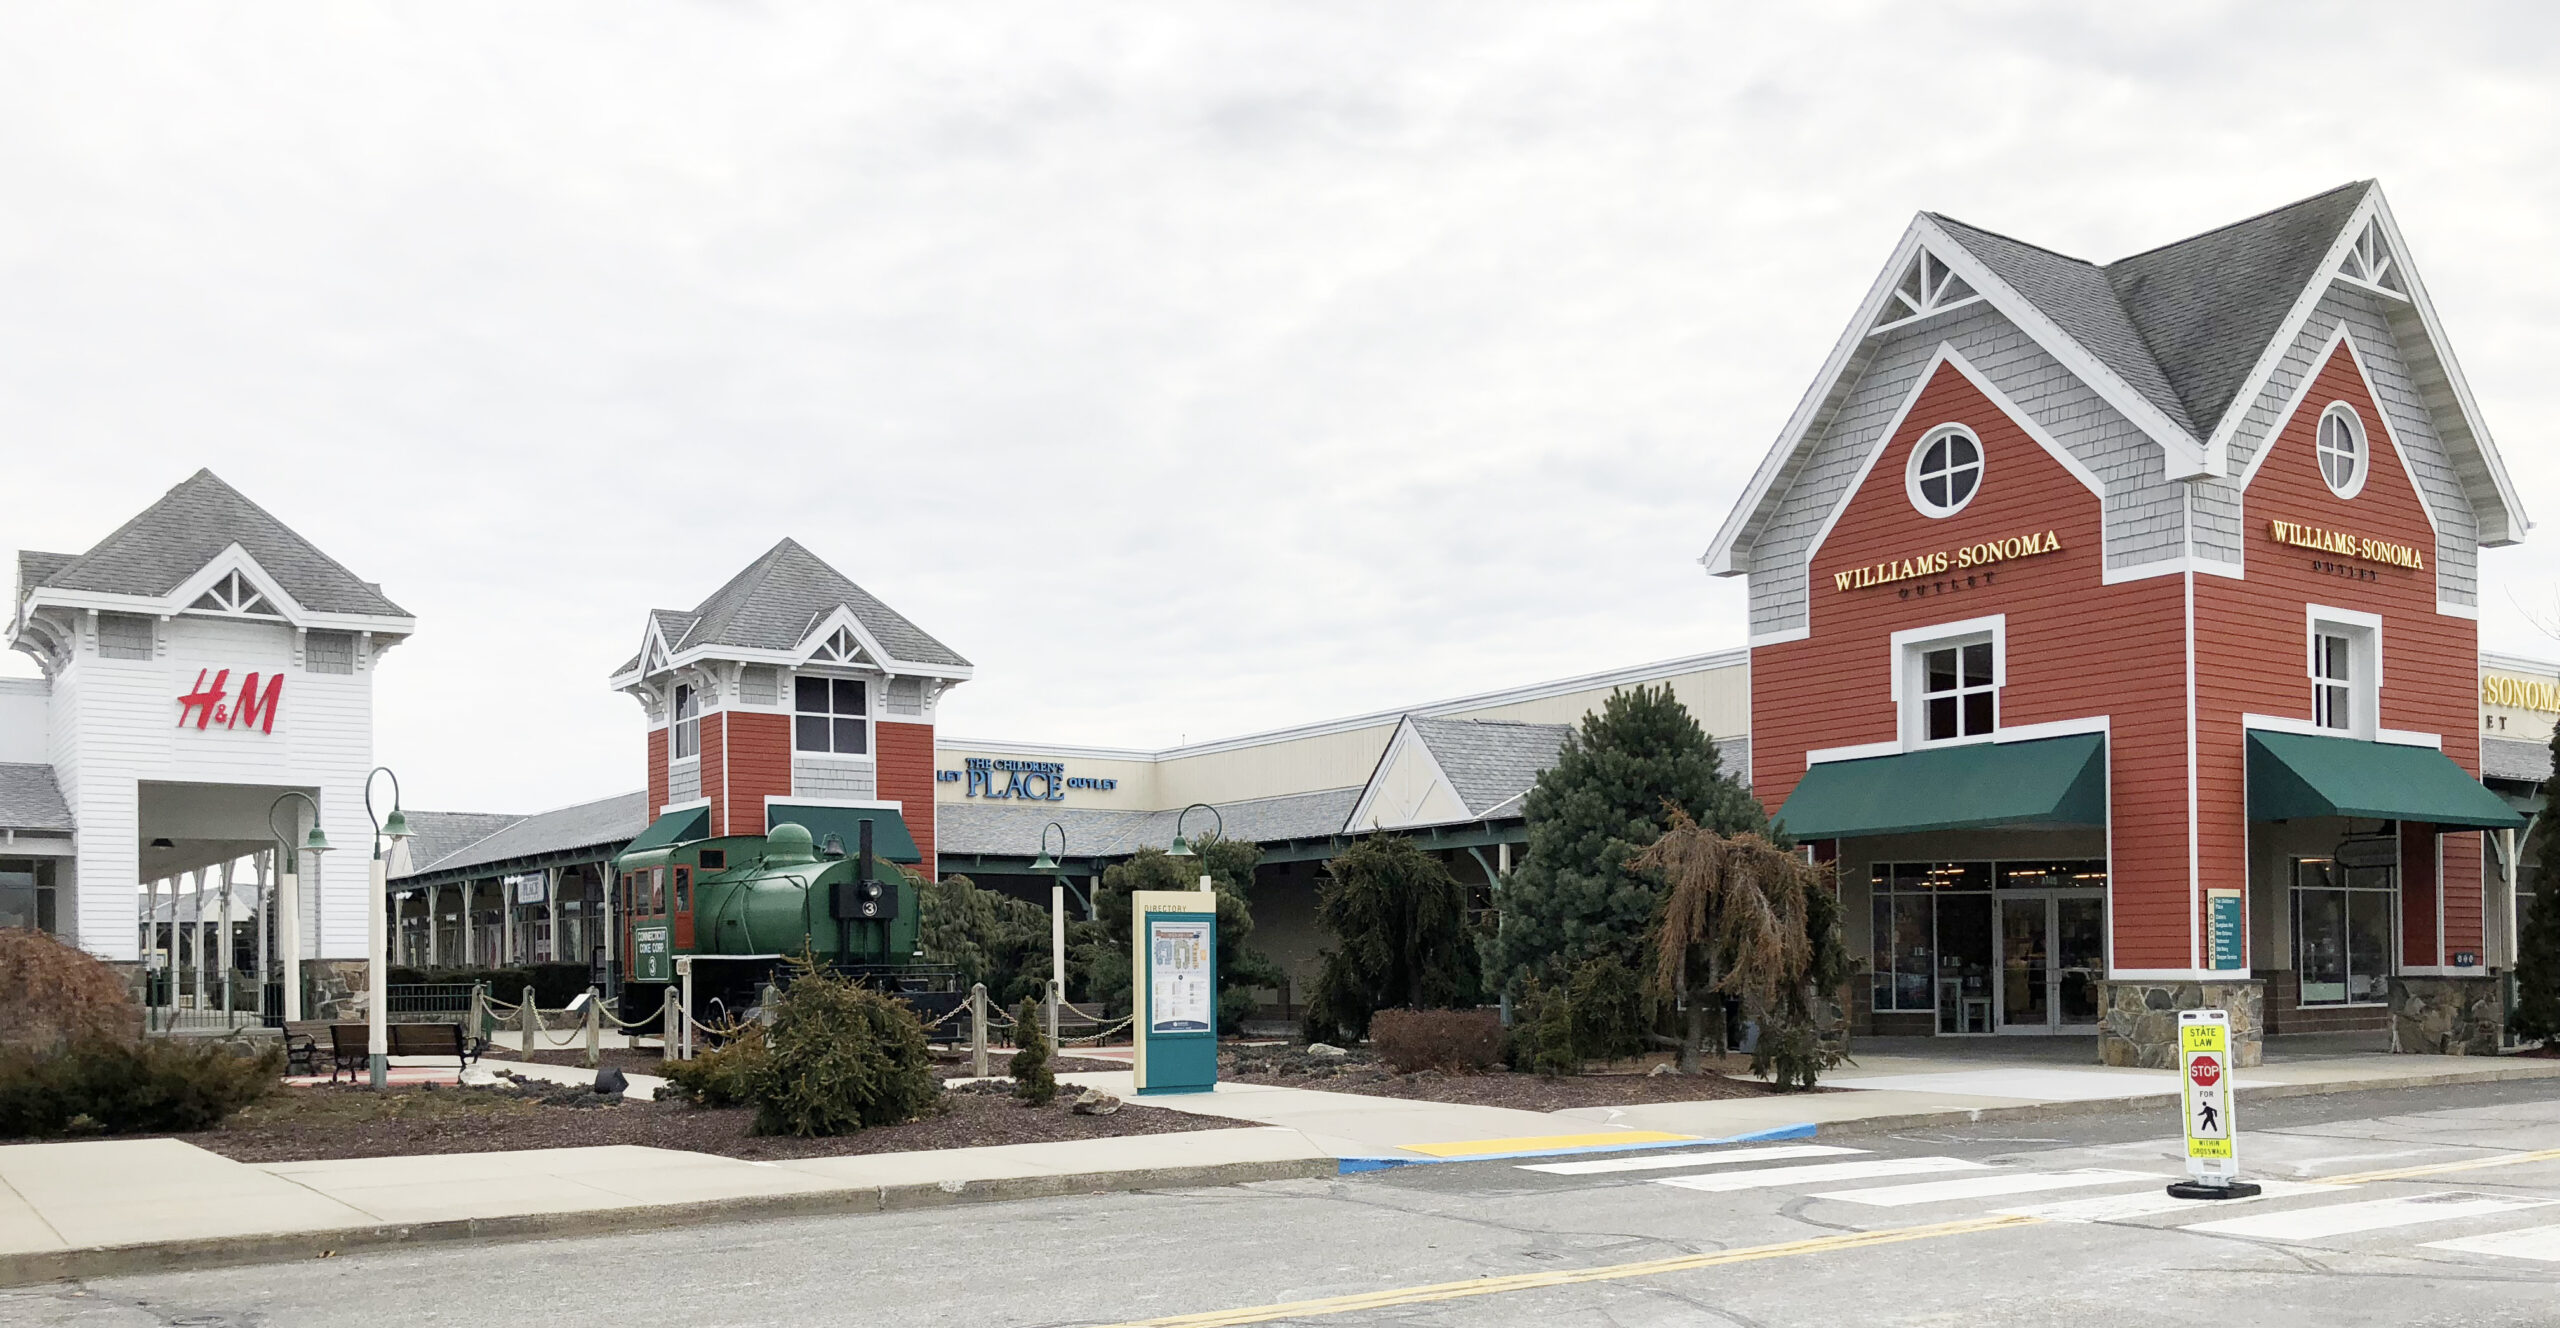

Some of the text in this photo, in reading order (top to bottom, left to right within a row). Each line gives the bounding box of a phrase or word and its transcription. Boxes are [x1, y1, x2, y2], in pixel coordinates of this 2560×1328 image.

[2272, 519, 2425, 570] WILLIAMS-SONOMA
[1834, 529, 2062, 592] WILLIAMS-SONOMA
[1899, 571, 1995, 599] OUTLET
[177, 667, 285, 736] H&M
[965, 757, 1065, 773] THE CHILDREN'S
[966, 768, 1065, 801] PLACE
[1066, 776, 1118, 791] OUTLET
[864, 902, 875, 914] 3
[1144, 904, 1187, 912] DIRECTORY
[637, 930, 666, 942] CONNECTICUT
[640, 943, 652, 953] COKE
[649, 957, 656, 976] 3
[2190, 1027, 2216, 1037] STATE
[2194, 1038, 2213, 1047] LAW
[2191, 1065, 2219, 1077] STOP
[2199, 1090, 2214, 1098] FOR
[2199, 1139, 2220, 1147] WITHIN
[2193, 1147, 2227, 1155] CROSSWALK
